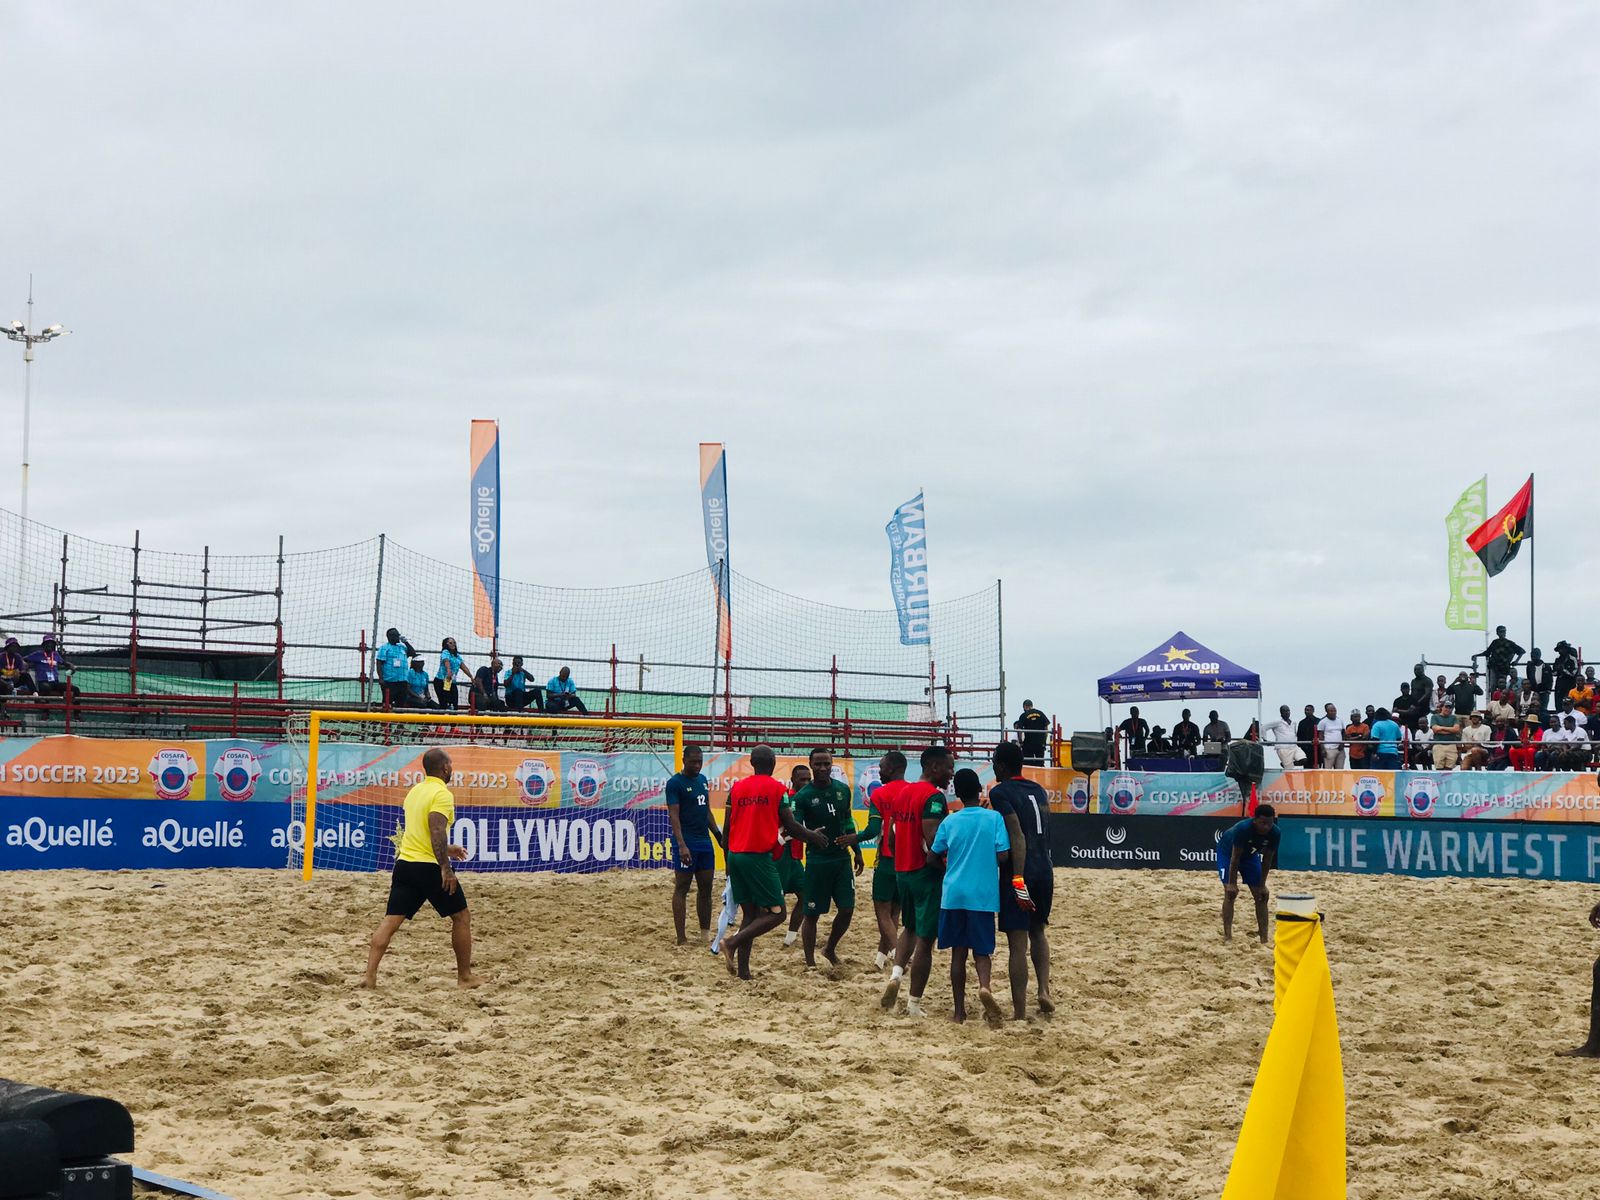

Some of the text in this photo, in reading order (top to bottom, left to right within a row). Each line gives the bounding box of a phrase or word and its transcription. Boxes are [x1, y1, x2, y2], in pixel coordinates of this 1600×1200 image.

[1137, 662, 1220, 673] HOLLYWOOD
[12, 764, 87, 783] SOCCER
[92, 766, 141, 784] 2023
[344, 769, 400, 787] BEACH
[403, 770, 464, 788] SOER
[468, 772, 508, 788] 2023
[697, 794, 706, 806] 12
[1150, 790, 1210, 804] COSAFA
[1267, 790, 1312, 804] SOCCER
[1315, 790, 1345, 804] 2023
[1444, 792, 1500, 808] COSAFA
[1503, 794, 1552, 810] BEACH
[827, 803, 836, 817] 4
[1028, 795, 1043, 834] 1
[6, 816, 114, 852] aQuellé
[142, 818, 244, 853] aQuellé
[452, 818, 636, 862] OLLYWOOD
[1071, 845, 1160, 860] Southern Sun
[1180, 848, 1217, 861] South
[1304, 826, 1368, 868] THE
[1382, 829, 1568, 877] WARMEST
